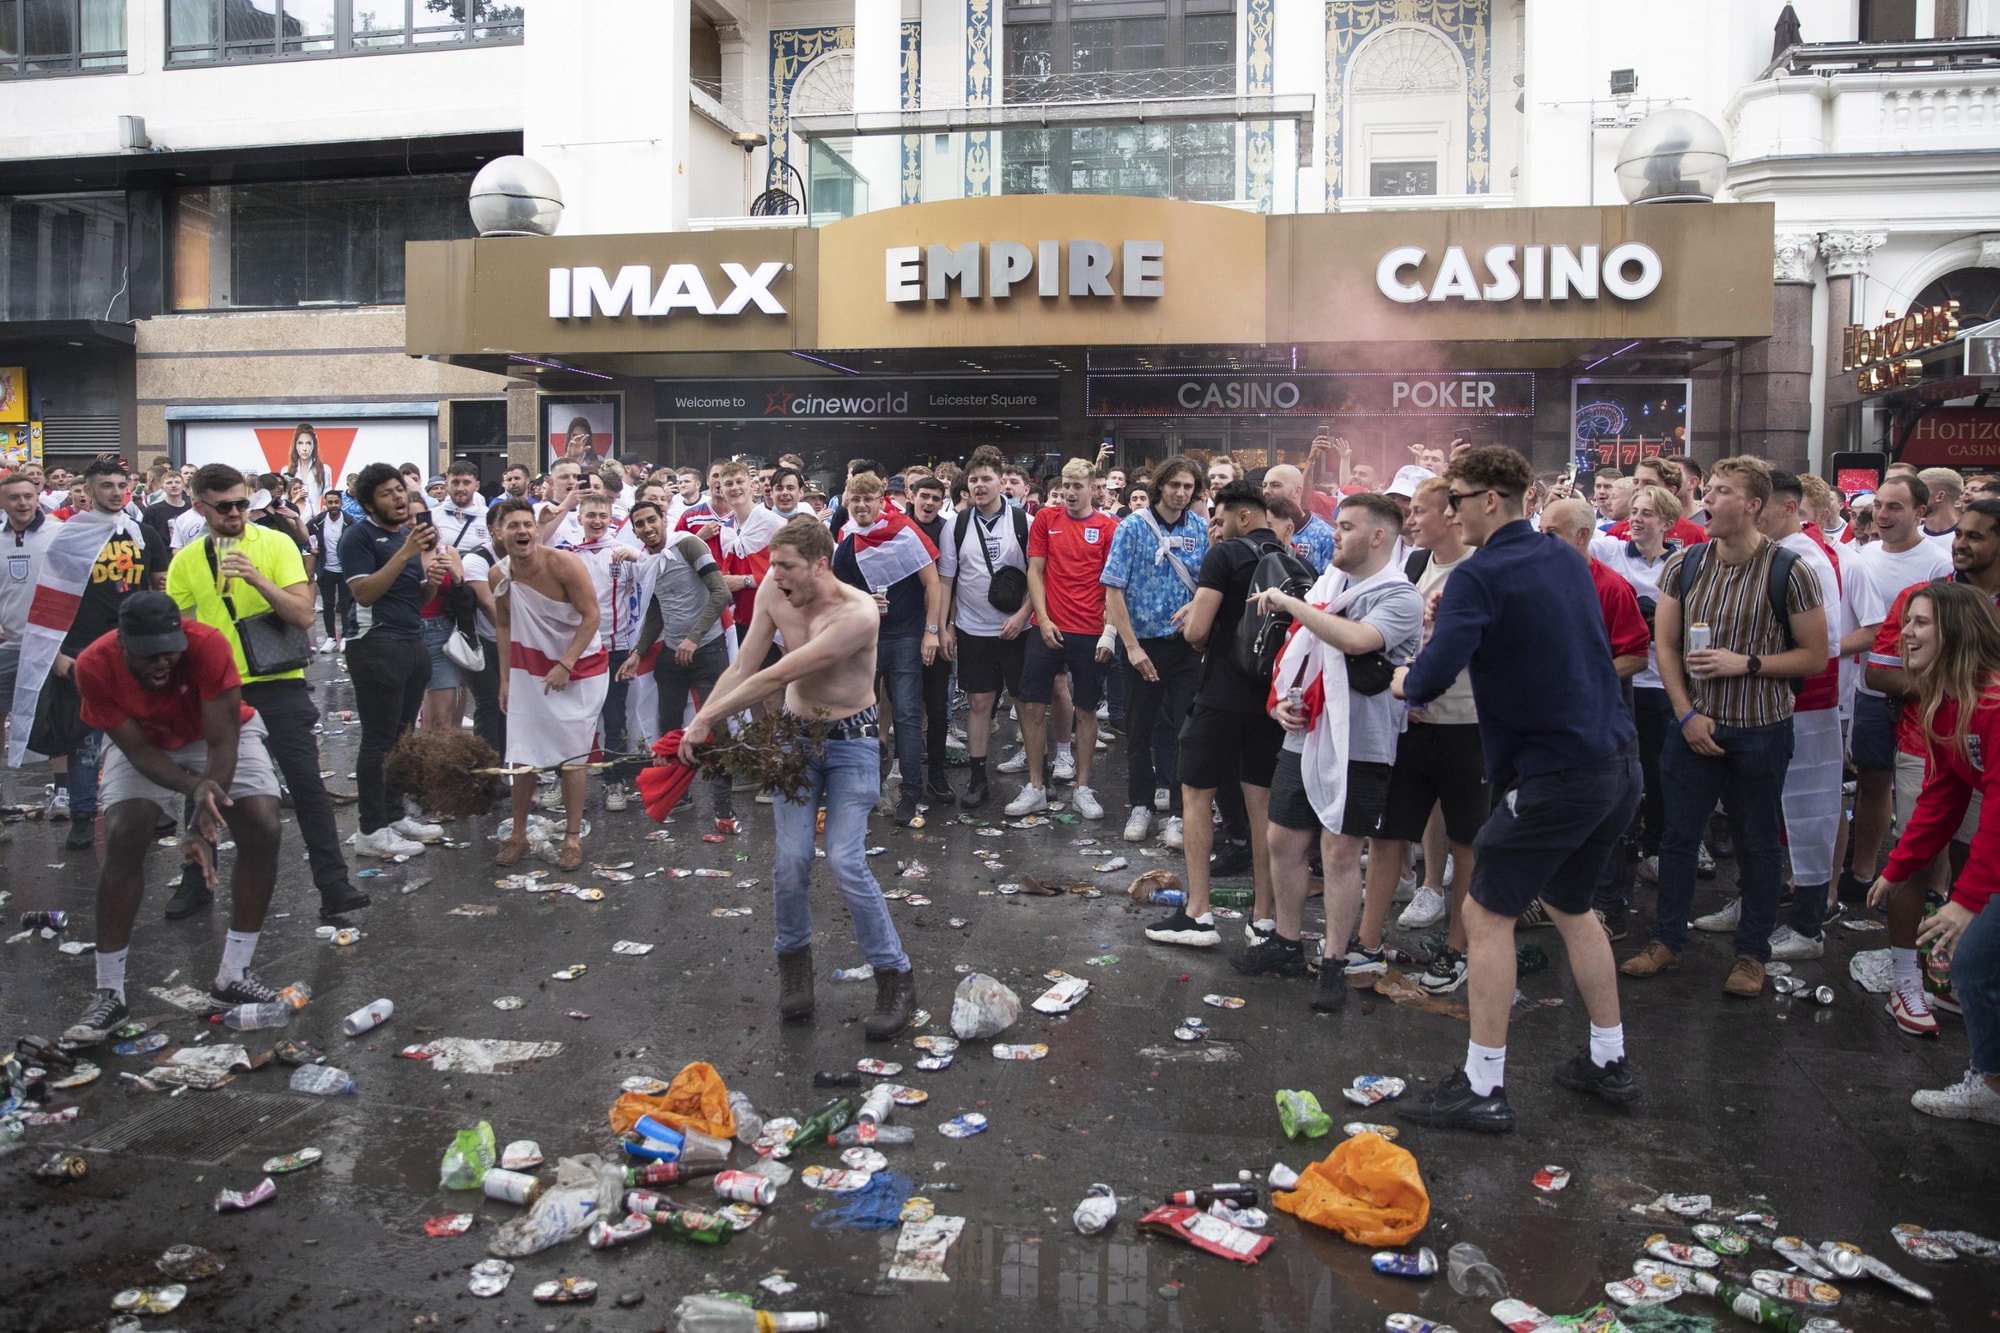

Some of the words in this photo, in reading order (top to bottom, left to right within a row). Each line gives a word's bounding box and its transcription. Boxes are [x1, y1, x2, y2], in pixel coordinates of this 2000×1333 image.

[886, 240, 1164, 303] EMPIRE
[1376, 241, 1662, 303] CASINO
[548, 262, 787, 319] IMAX
[675, 396, 730, 408] Welcome
[733, 397, 746, 408] to
[791, 391, 908, 414] cineworld
[929, 394, 989, 406] Leicester
[990, 393, 1037, 408] Square
[1177, 382, 1300, 409] CASINO
[1392, 381, 1496, 409] POKER
[1947, 444, 2000, 456] CASIN
